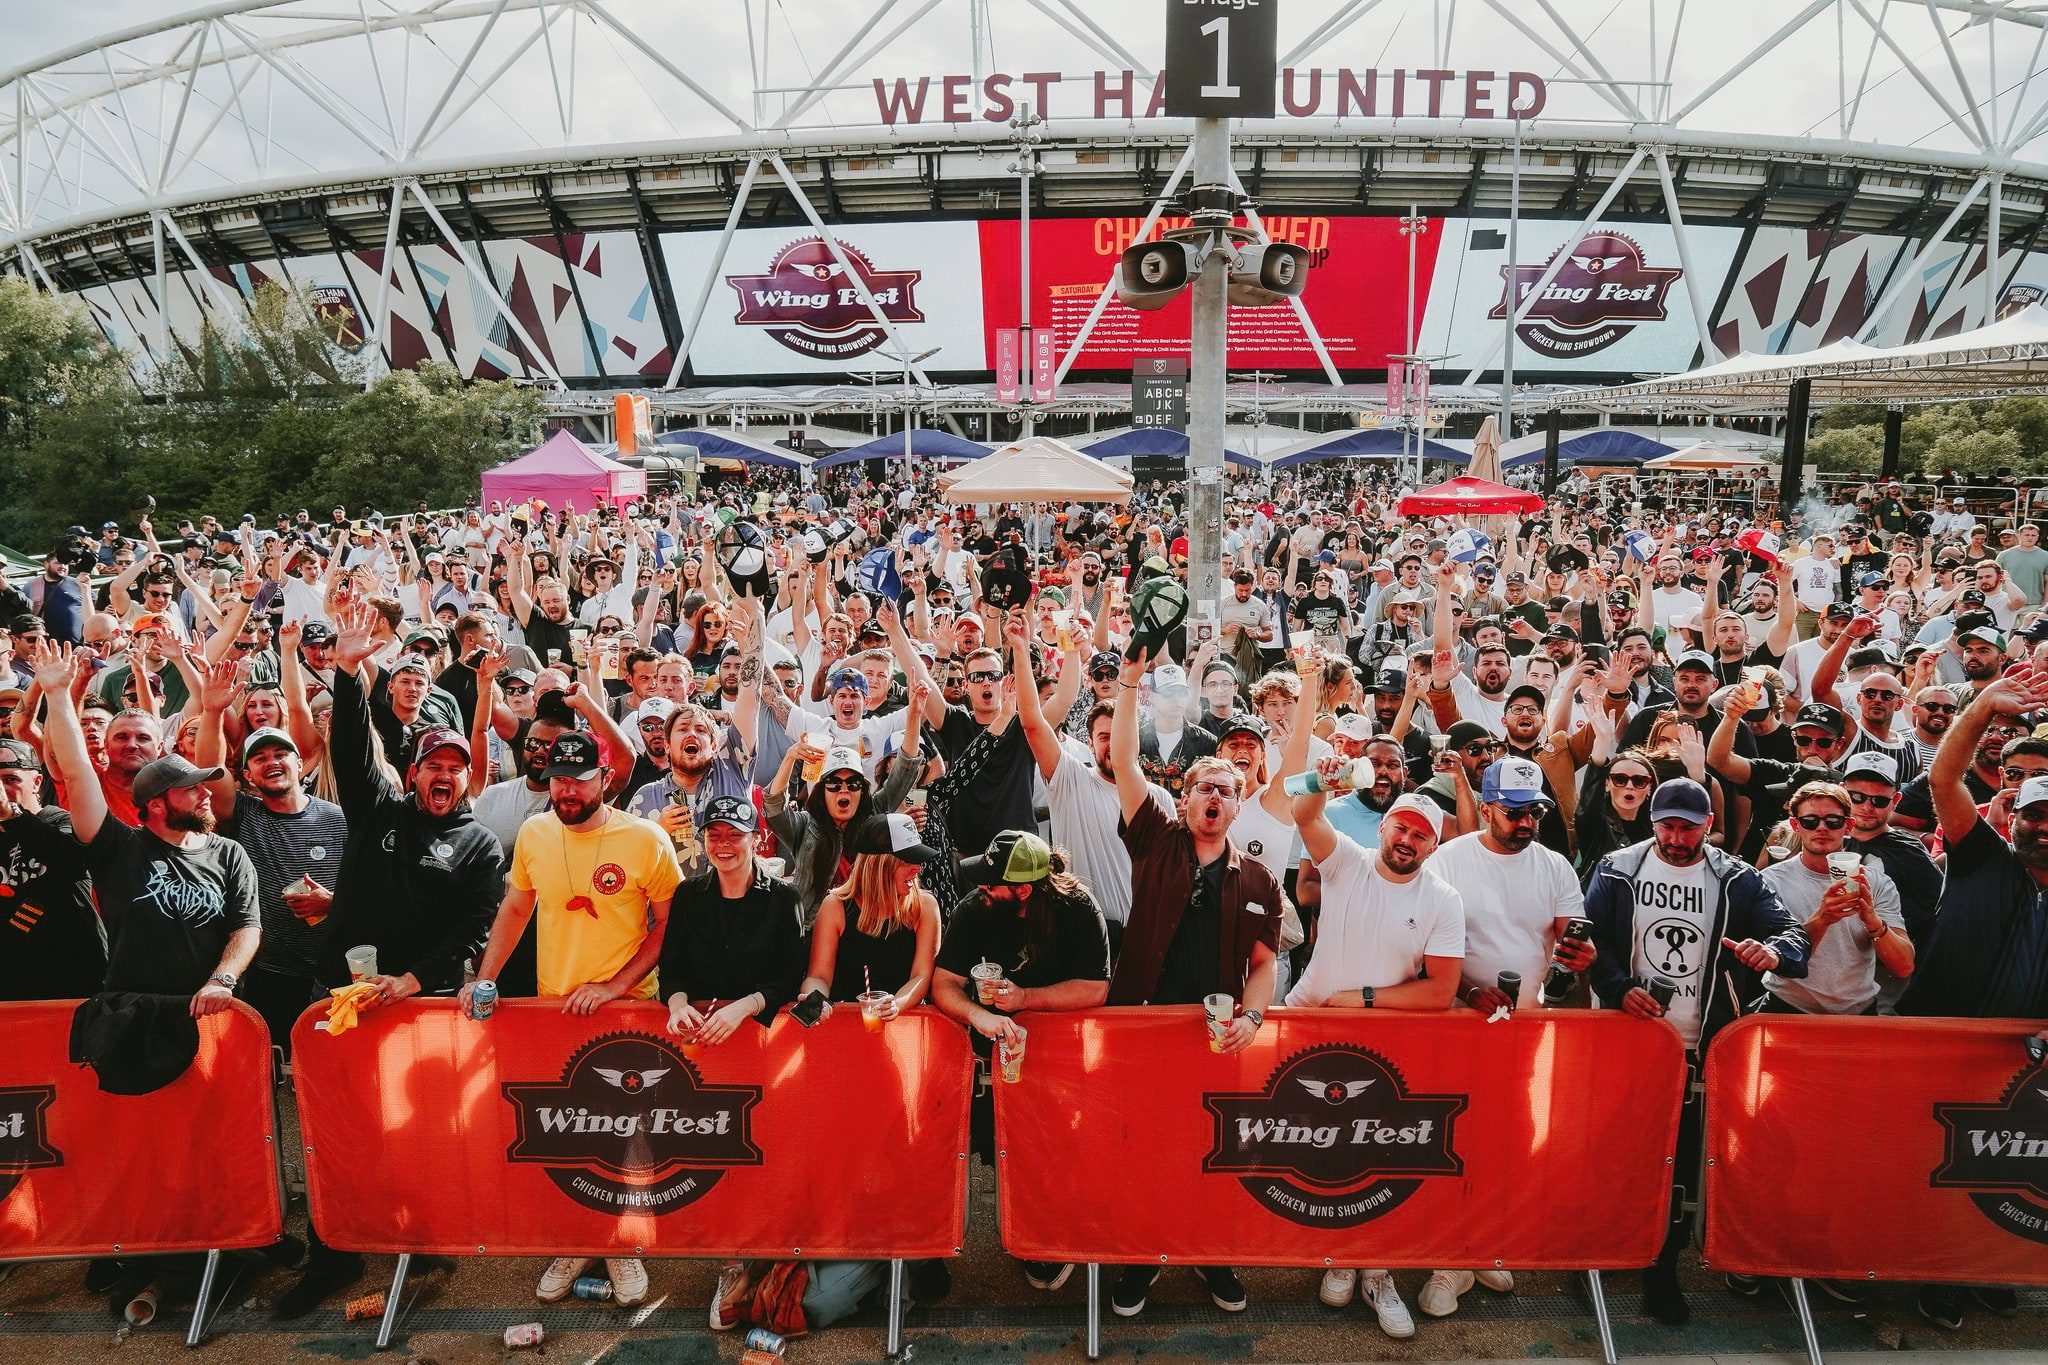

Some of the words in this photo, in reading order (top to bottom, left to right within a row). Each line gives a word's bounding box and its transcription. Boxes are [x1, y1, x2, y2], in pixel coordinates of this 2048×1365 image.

[1200, 17, 1240, 97] 1
[873, 72, 1062, 125] WEST
[1094, 70, 1166, 119] HA
[1282, 68, 1547, 119] UNITED
[326, 288, 347, 298] HAM
[752, 289, 830, 309] Wing
[1060, 286, 1094, 295] SATURDAY
[1597, 283, 1657, 301] Fest
[784, 332, 815, 351] CHICKEN
[817, 344, 837, 353] WING
[838, 332, 878, 353] SHOWDOWN
[1529, 328, 1553, 348] CHICKEN
[1554, 340, 1573, 351] WING
[1574, 329, 1616, 351] SHOWDOWN
[1003, 333, 1012, 386] PLAY
[969, 417, 979, 429] H
[791, 438, 799, 447] H
[1250, 844, 1260, 852] W
[1636, 879, 1705, 914] OSCHI
[1638, 975, 1696, 998] MAN
[535, 1107, 643, 1137] Wing
[649, 1108, 730, 1135] Fest
[1235, 1117, 1341, 1148] Wing
[1350, 1118, 1434, 1145] Fest
[572, 1176, 614, 1203] CHICKEN
[616, 1193, 641, 1207] WING
[643, 1176, 697, 1207] SHOWDOWN
[1266, 1184, 1306, 1213] CHICKEN
[1308, 1202, 1334, 1218] WING
[1337, 1187, 1393, 1217] SHOWDOWN
[1999, 1201, 2041, 1230] CHICKEN
